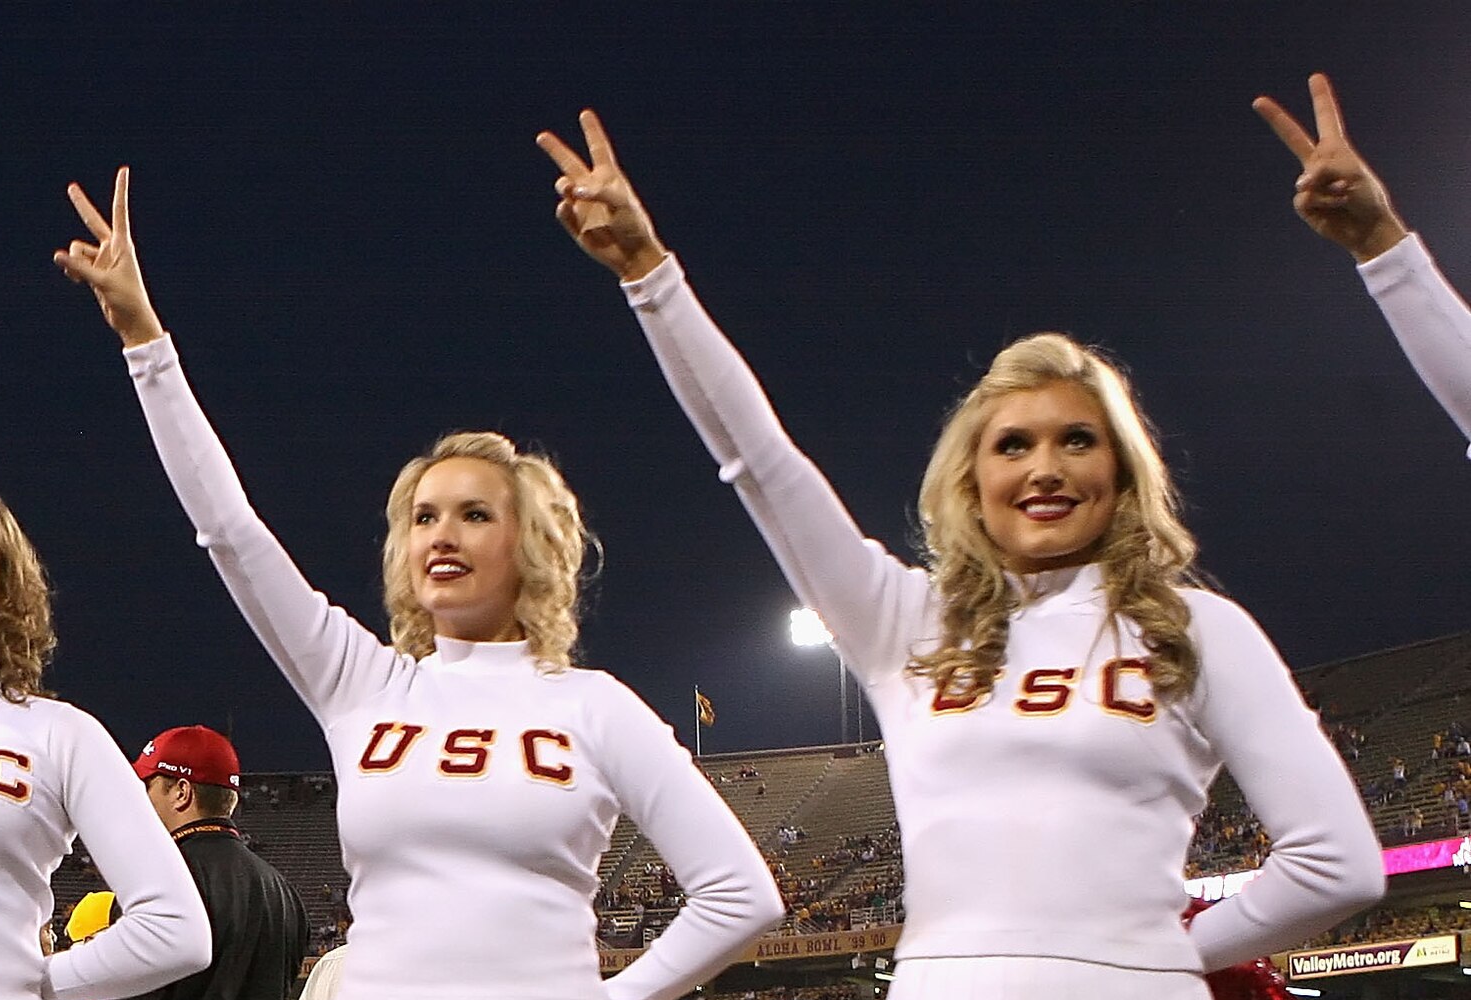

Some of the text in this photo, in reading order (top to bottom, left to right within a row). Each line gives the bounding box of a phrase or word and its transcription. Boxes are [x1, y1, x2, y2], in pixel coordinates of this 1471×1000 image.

[358, 721, 574, 788] USC
[179, 765, 192, 776] V1
[756, 940, 801, 958] ALOHA
[807, 937, 842, 952] BOWL
[1292, 948, 1401, 976] ValleyMetro.org
